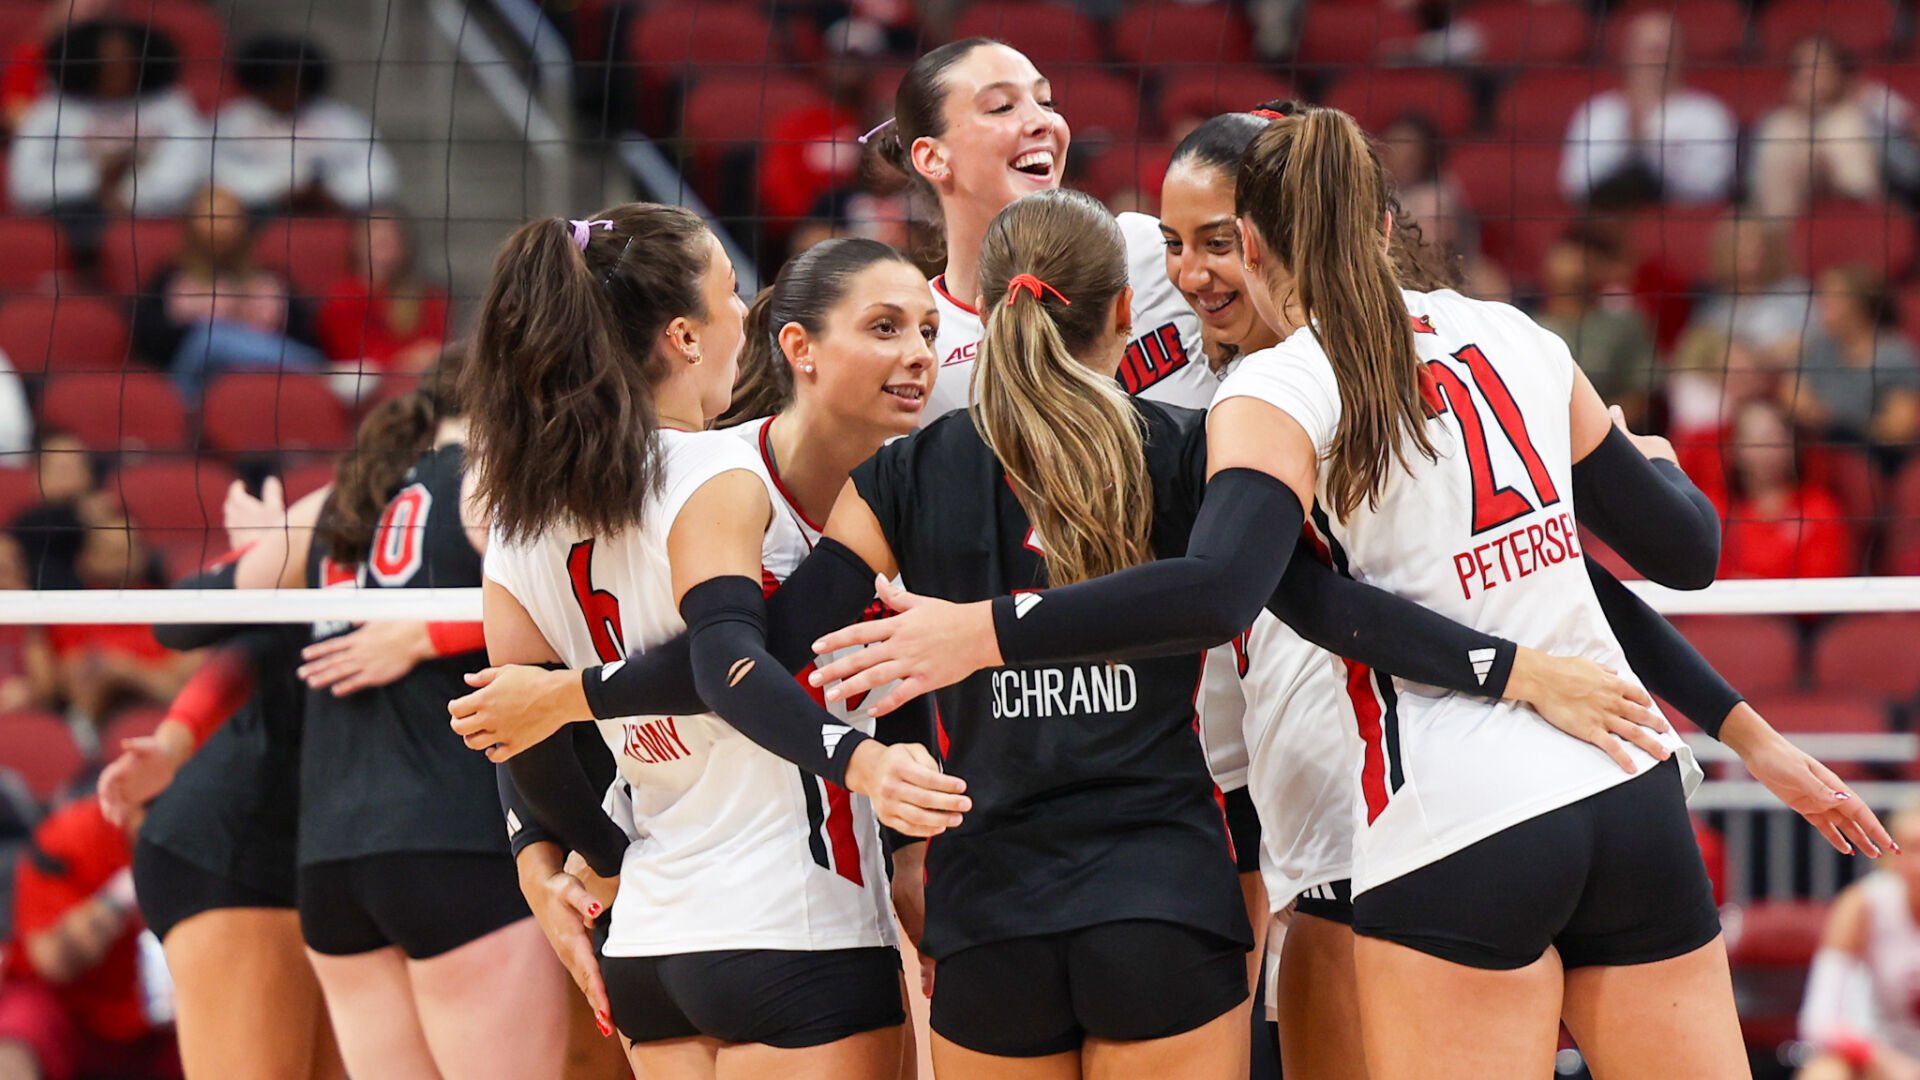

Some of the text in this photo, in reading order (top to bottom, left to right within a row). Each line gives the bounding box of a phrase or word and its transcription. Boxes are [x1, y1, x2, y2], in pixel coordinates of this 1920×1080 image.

[1416, 343, 1561, 537] 21
[1453, 512, 1580, 600] PETERSE
[992, 664, 1138, 719] SCHRAND
[622, 716, 691, 764] KENNY
